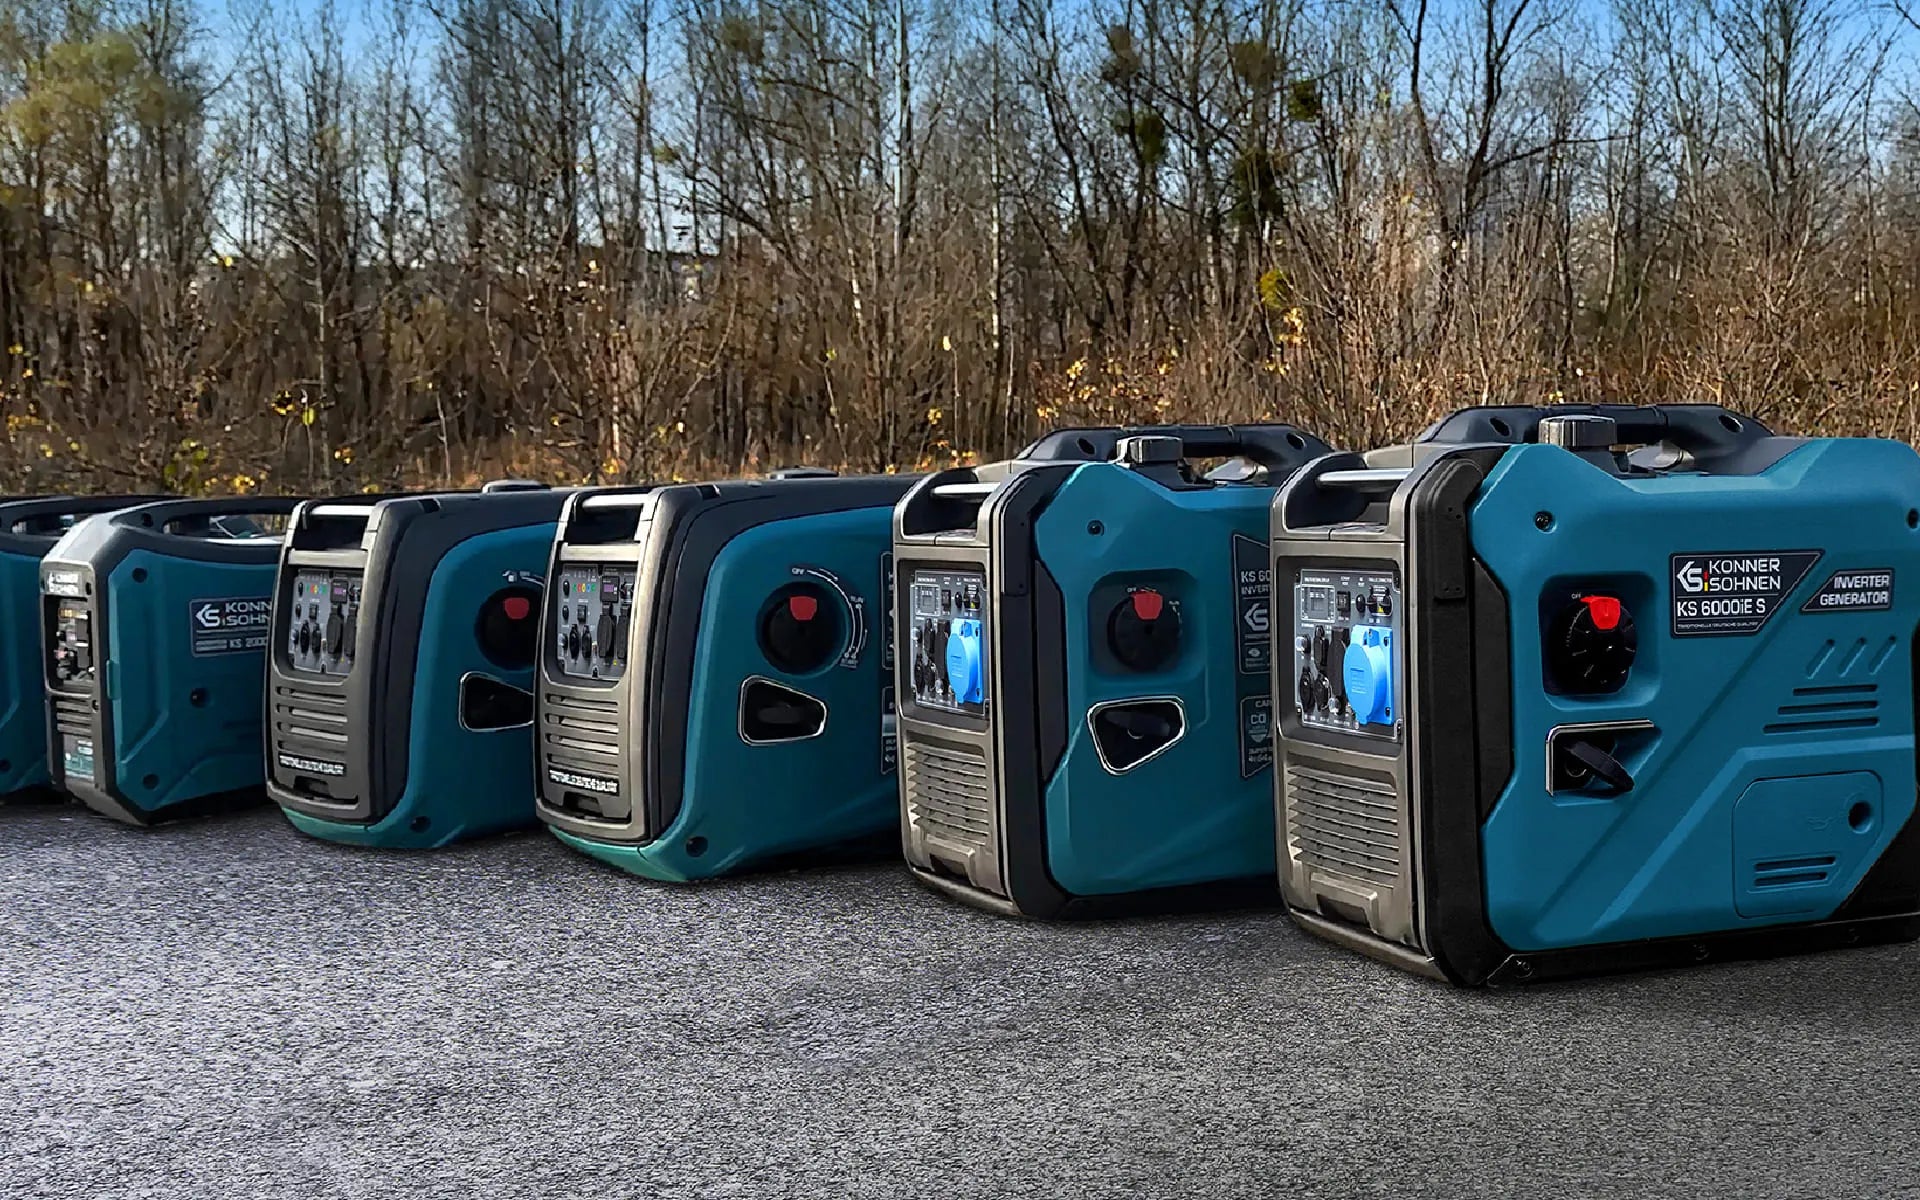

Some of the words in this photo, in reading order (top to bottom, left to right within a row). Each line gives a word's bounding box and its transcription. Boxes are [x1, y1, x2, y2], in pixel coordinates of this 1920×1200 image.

[1708, 557, 1781, 575] KONNER
[1241, 570, 1257, 583] KS
[1708, 575, 1781, 592] SOHNEN
[1833, 574, 1890, 590] INVERTER
[225, 601, 273, 613] KONN
[1819, 591, 1889, 607] GENERATOR
[1676, 601, 1698, 618] KS
[1701, 598, 1754, 617] 6000iE
[1755, 597, 1767, 615] S
[225, 614, 271, 627] SOHN
